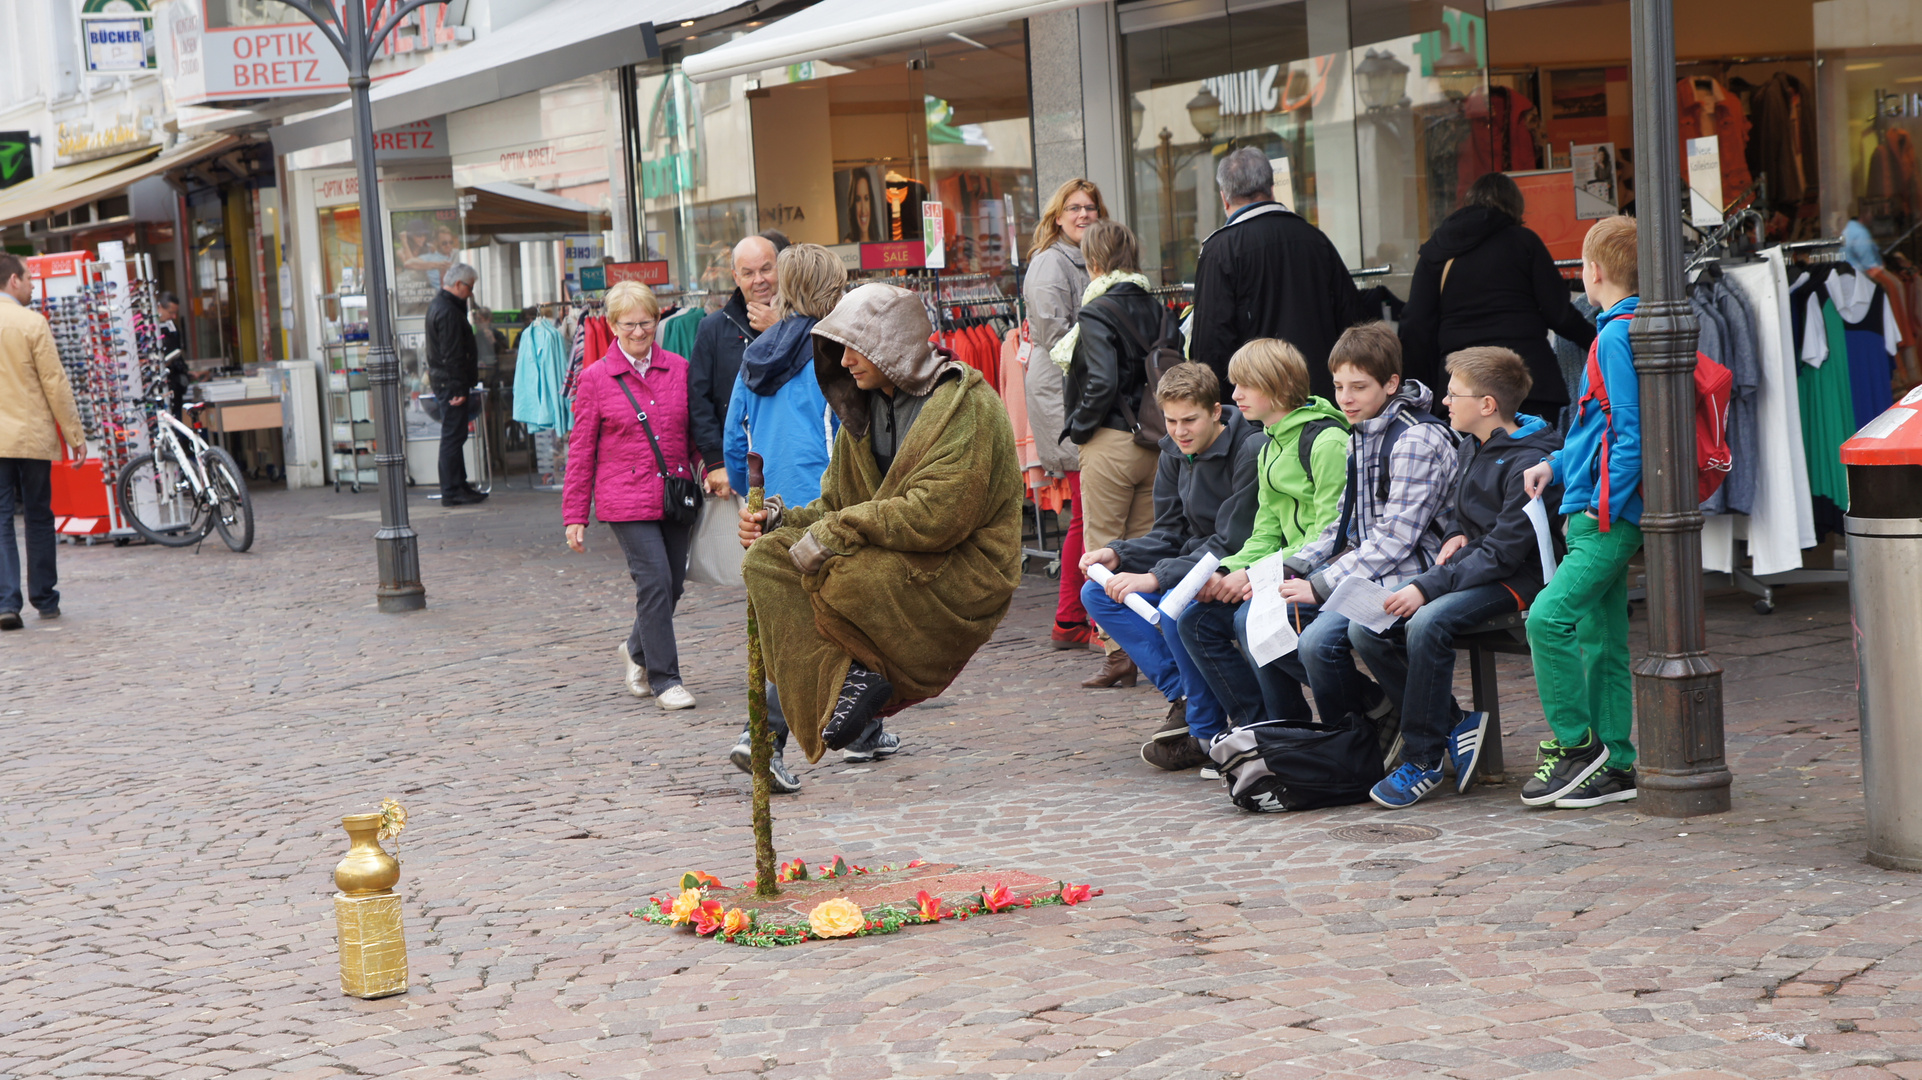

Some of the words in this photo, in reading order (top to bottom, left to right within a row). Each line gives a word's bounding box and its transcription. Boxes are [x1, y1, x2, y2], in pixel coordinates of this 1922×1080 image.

[90, 29, 141, 44] BÜCHER
[233, 32, 315, 59] OPTIK
[234, 59, 321, 87] BRETZ
[500, 151, 526, 172] OPTIK
[528, 146, 557, 168] BRETZ
[323, 177, 344, 198] OPTIK
[346, 177, 359, 195] BRE
[883, 251, 909, 263] SALE
[612, 267, 660, 281] Special
